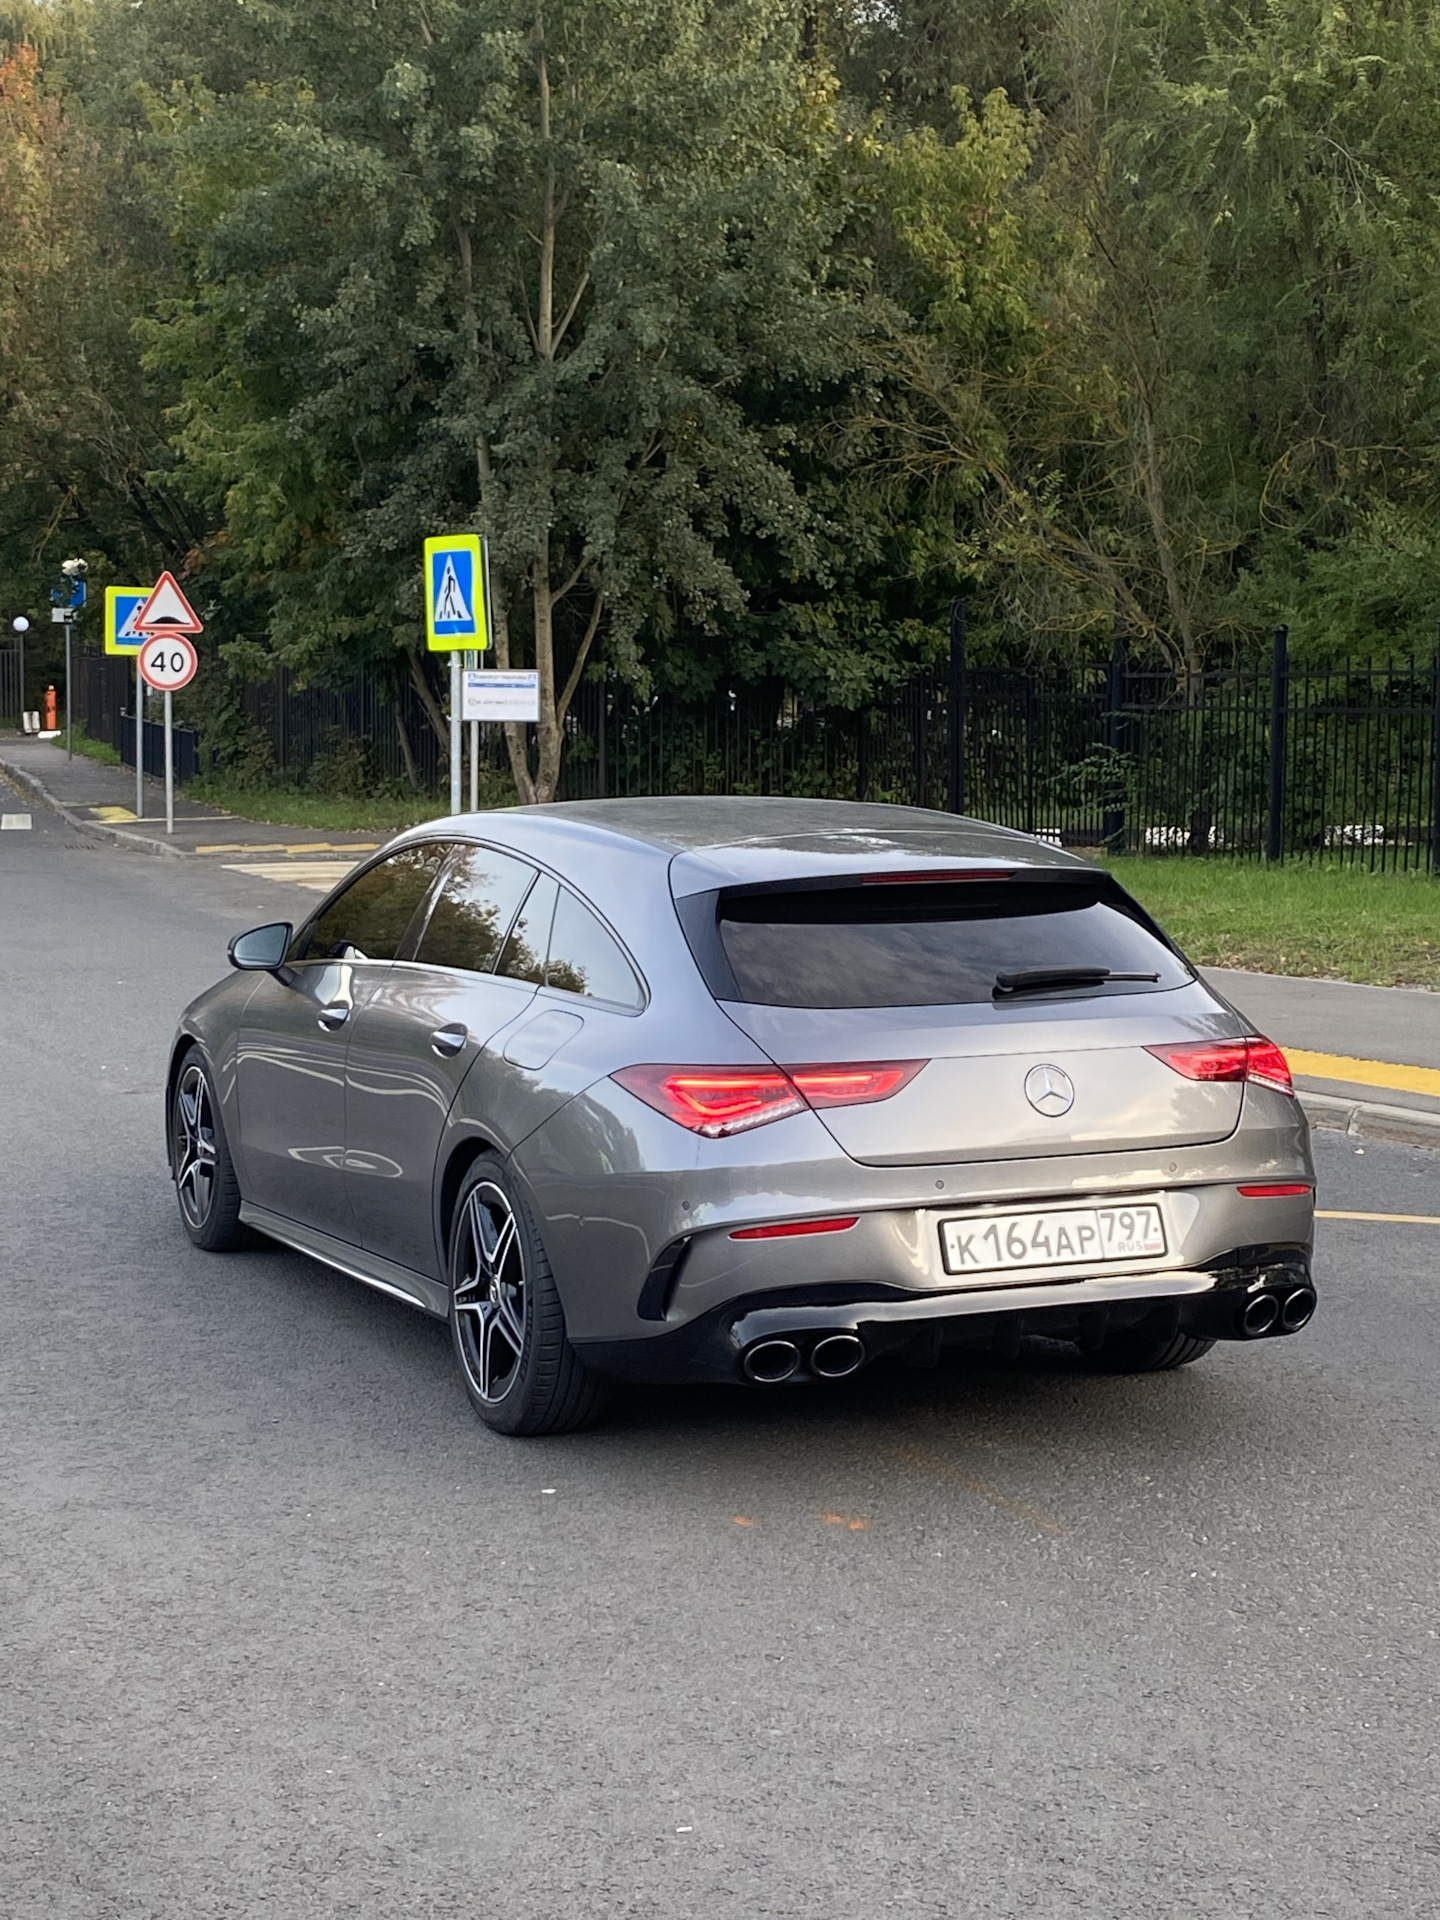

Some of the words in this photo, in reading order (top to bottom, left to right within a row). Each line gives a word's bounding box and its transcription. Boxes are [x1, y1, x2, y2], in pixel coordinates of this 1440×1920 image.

[151, 651, 184, 673] 40
[1100, 1210, 1151, 1242] 797
[1118, 1239, 1144, 1253] RUS
